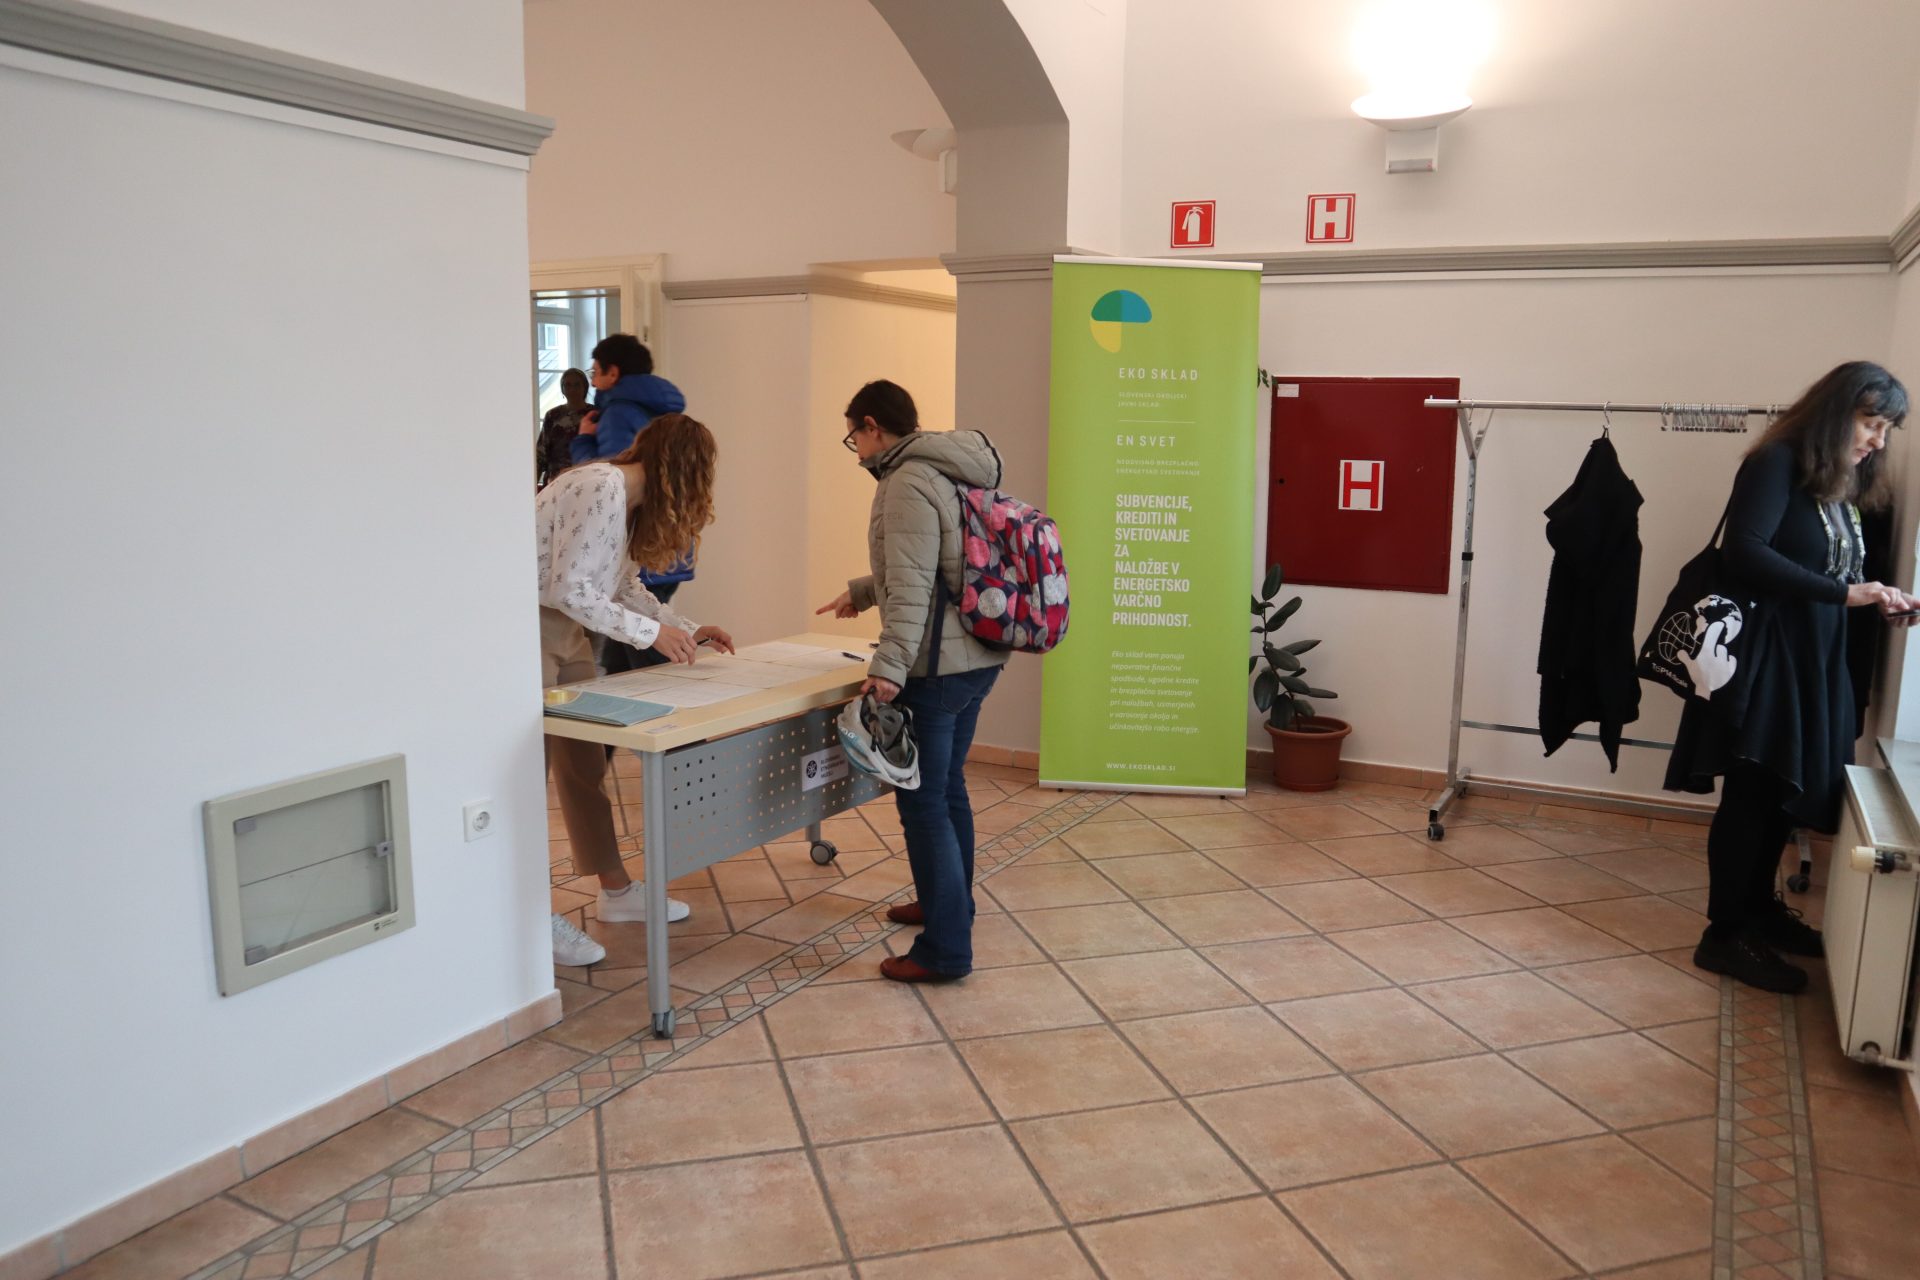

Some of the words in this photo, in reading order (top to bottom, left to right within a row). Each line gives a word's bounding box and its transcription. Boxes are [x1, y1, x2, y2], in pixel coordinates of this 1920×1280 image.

[1313, 198, 1349, 239] H
[1119, 367, 1145, 379] EKO
[1151, 368, 1199, 380] SKLAD
[1116, 435, 1134, 446] EN
[1139, 435, 1176, 447] SVET
[1342, 461, 1380, 508] H
[1116, 494, 1193, 512] SUBVENCIJE,
[1115, 511, 1162, 525] KREDITI
[1164, 512, 1177, 525] IN
[1115, 527, 1190, 543] SVETOVANJE
[1114, 544, 1130, 557] ZA
[1115, 558, 1169, 575] NALOŽBE
[1171, 562, 1180, 575] V
[1113, 577, 1190, 592] ENERGETSKO
[1112, 591, 1162, 608] VARČNO
[1112, 612, 1192, 627] PRIHODNOST.
[1125, 651, 1144, 659] sklad
